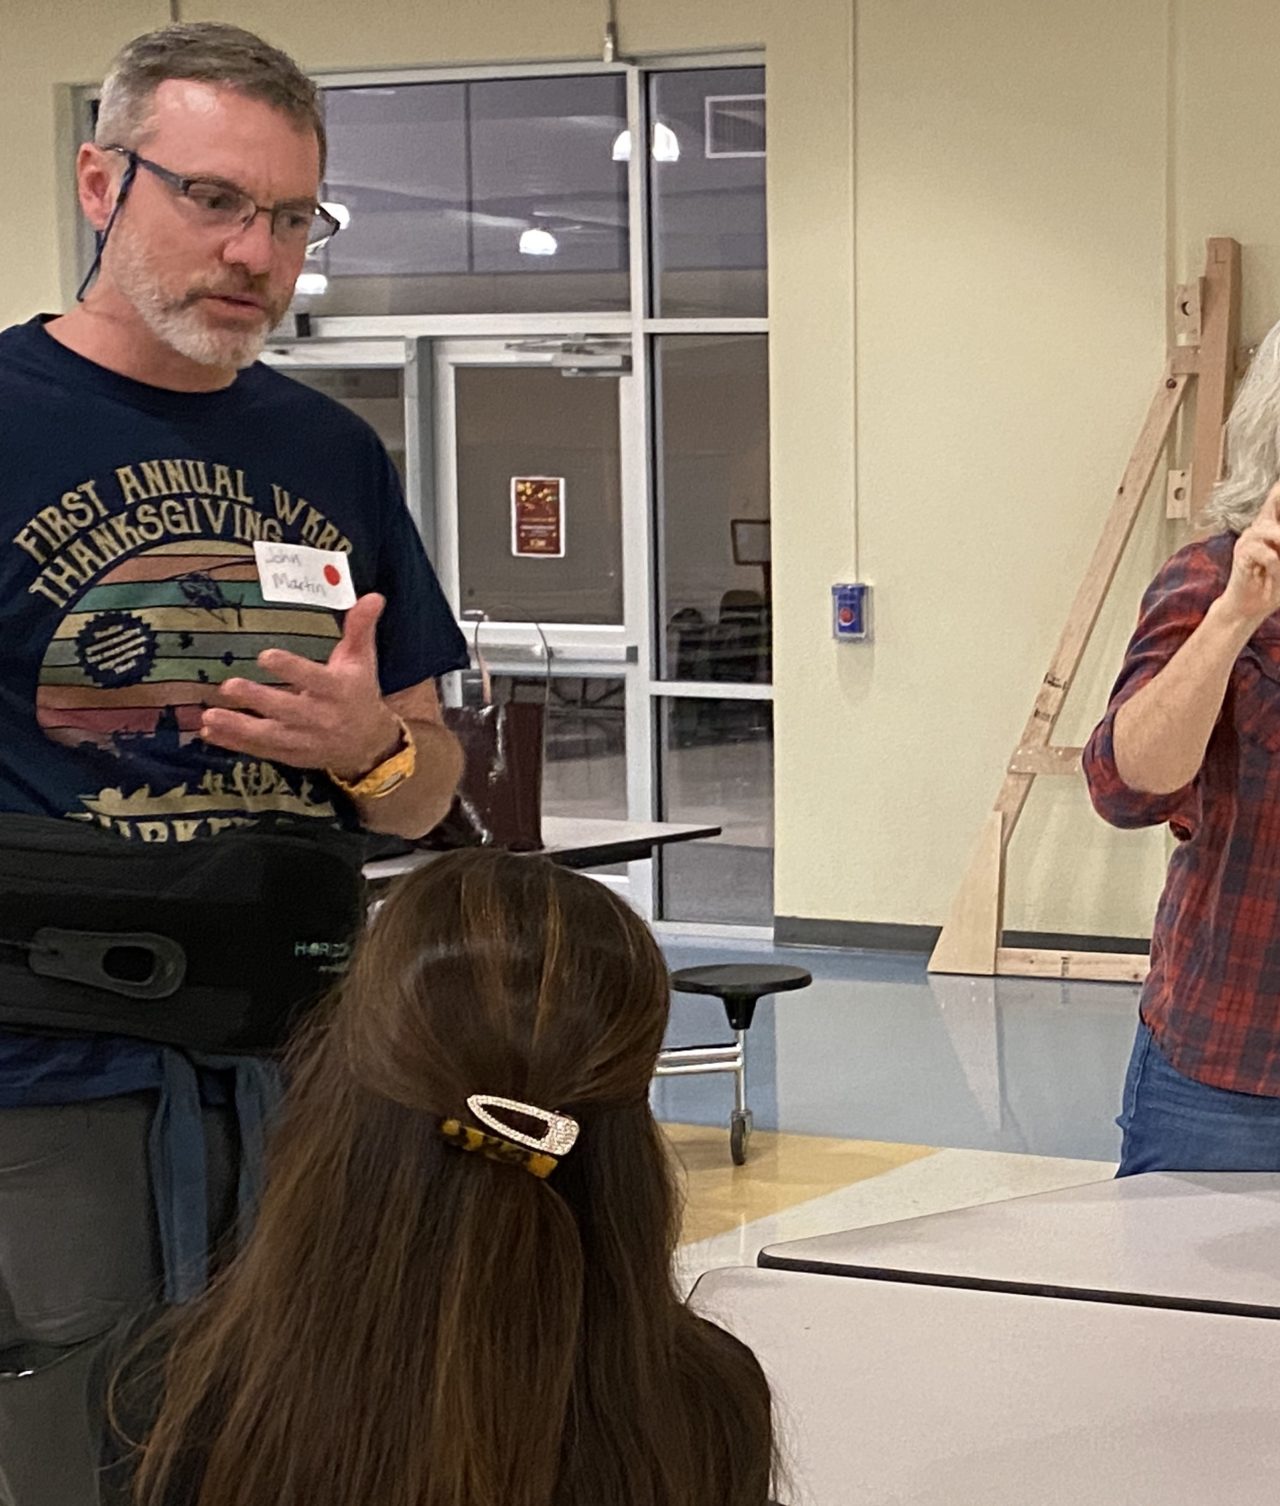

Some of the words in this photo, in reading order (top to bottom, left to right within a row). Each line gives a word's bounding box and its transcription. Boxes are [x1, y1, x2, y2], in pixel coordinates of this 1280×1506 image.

[13, 480, 109, 566] FIRST
[115, 459, 254, 505] ANNUAL
[29, 497, 282, 608] THANKSGIVING
[272, 572, 327, 597] Martin
